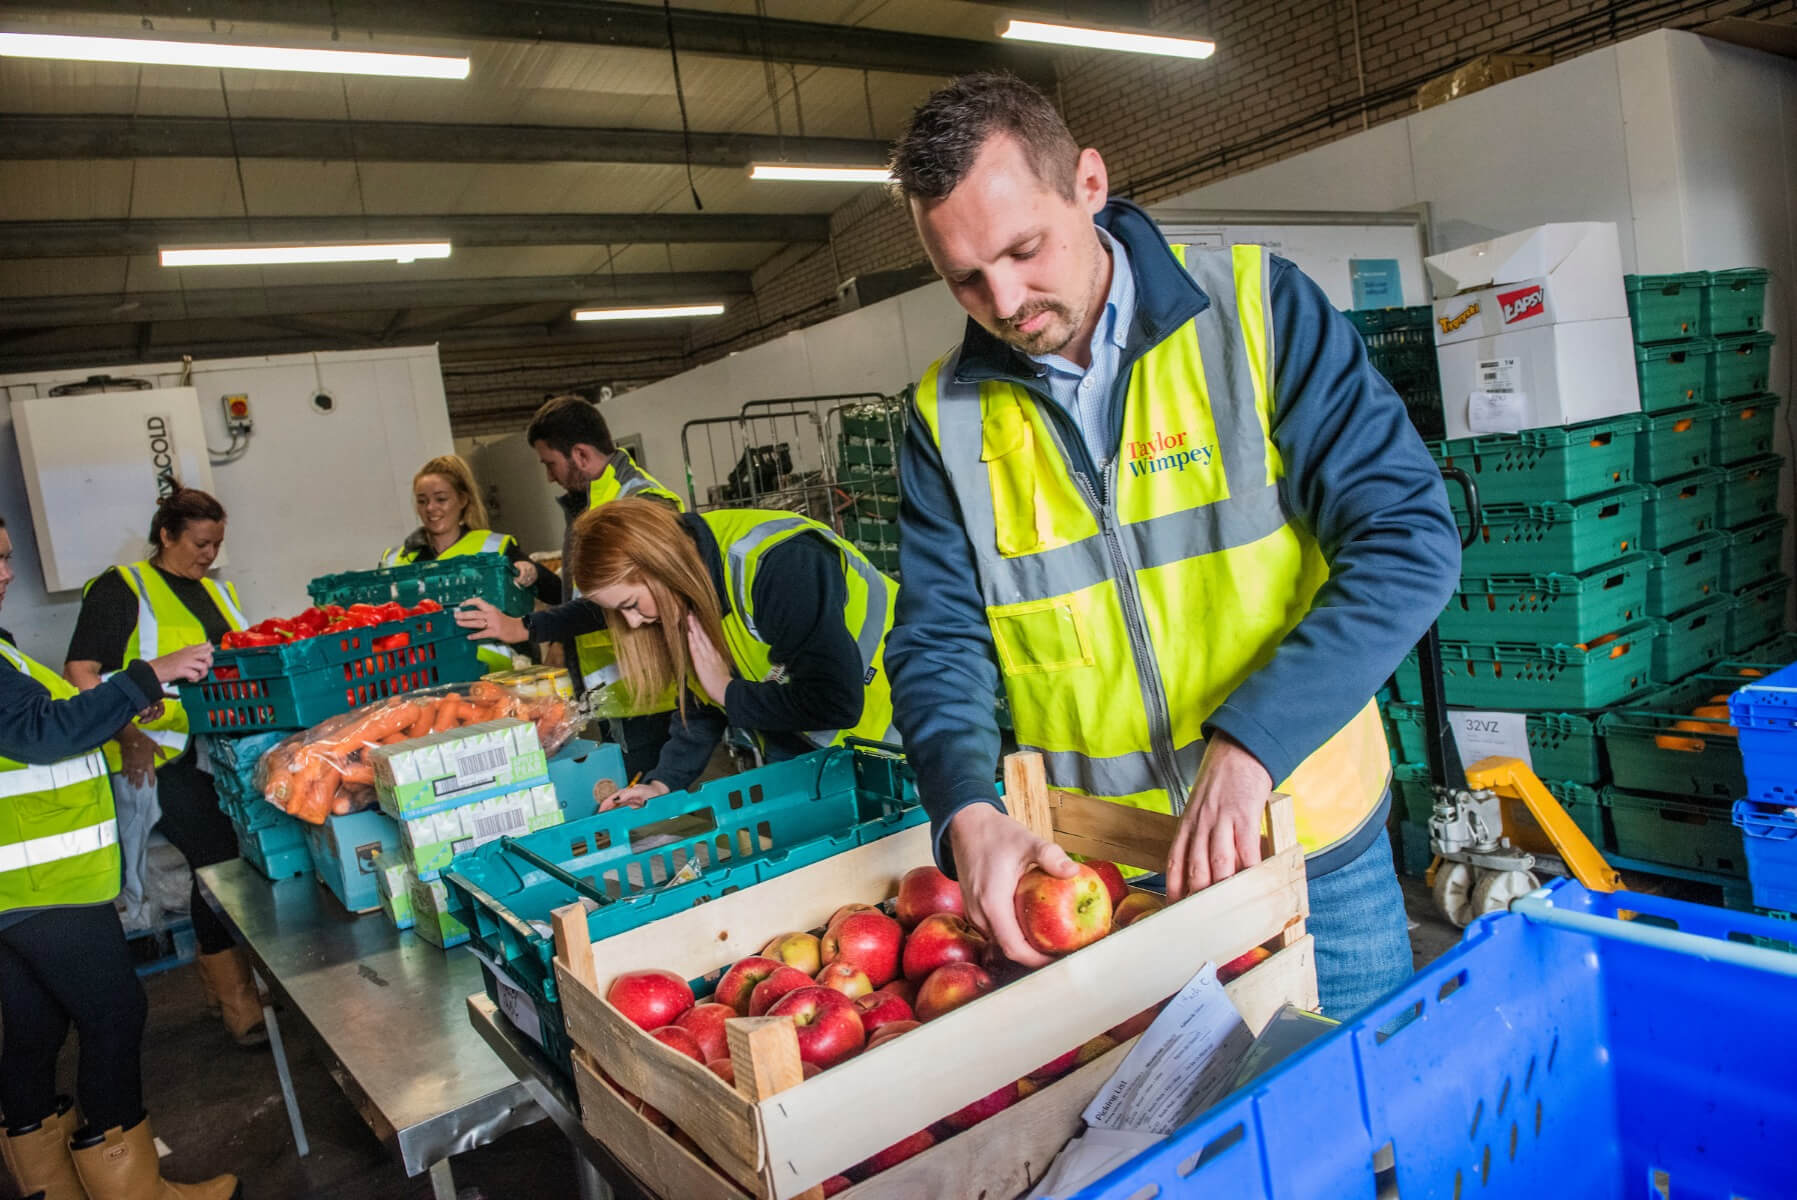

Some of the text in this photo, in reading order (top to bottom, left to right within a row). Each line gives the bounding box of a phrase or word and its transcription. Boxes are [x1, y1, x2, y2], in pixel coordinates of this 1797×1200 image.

[1126, 431, 1187, 460] Taylor
[1129, 444, 1214, 477] Wimpey
[1465, 719, 1499, 733] 32VZ
[1095, 1089, 1119, 1121] Picking
